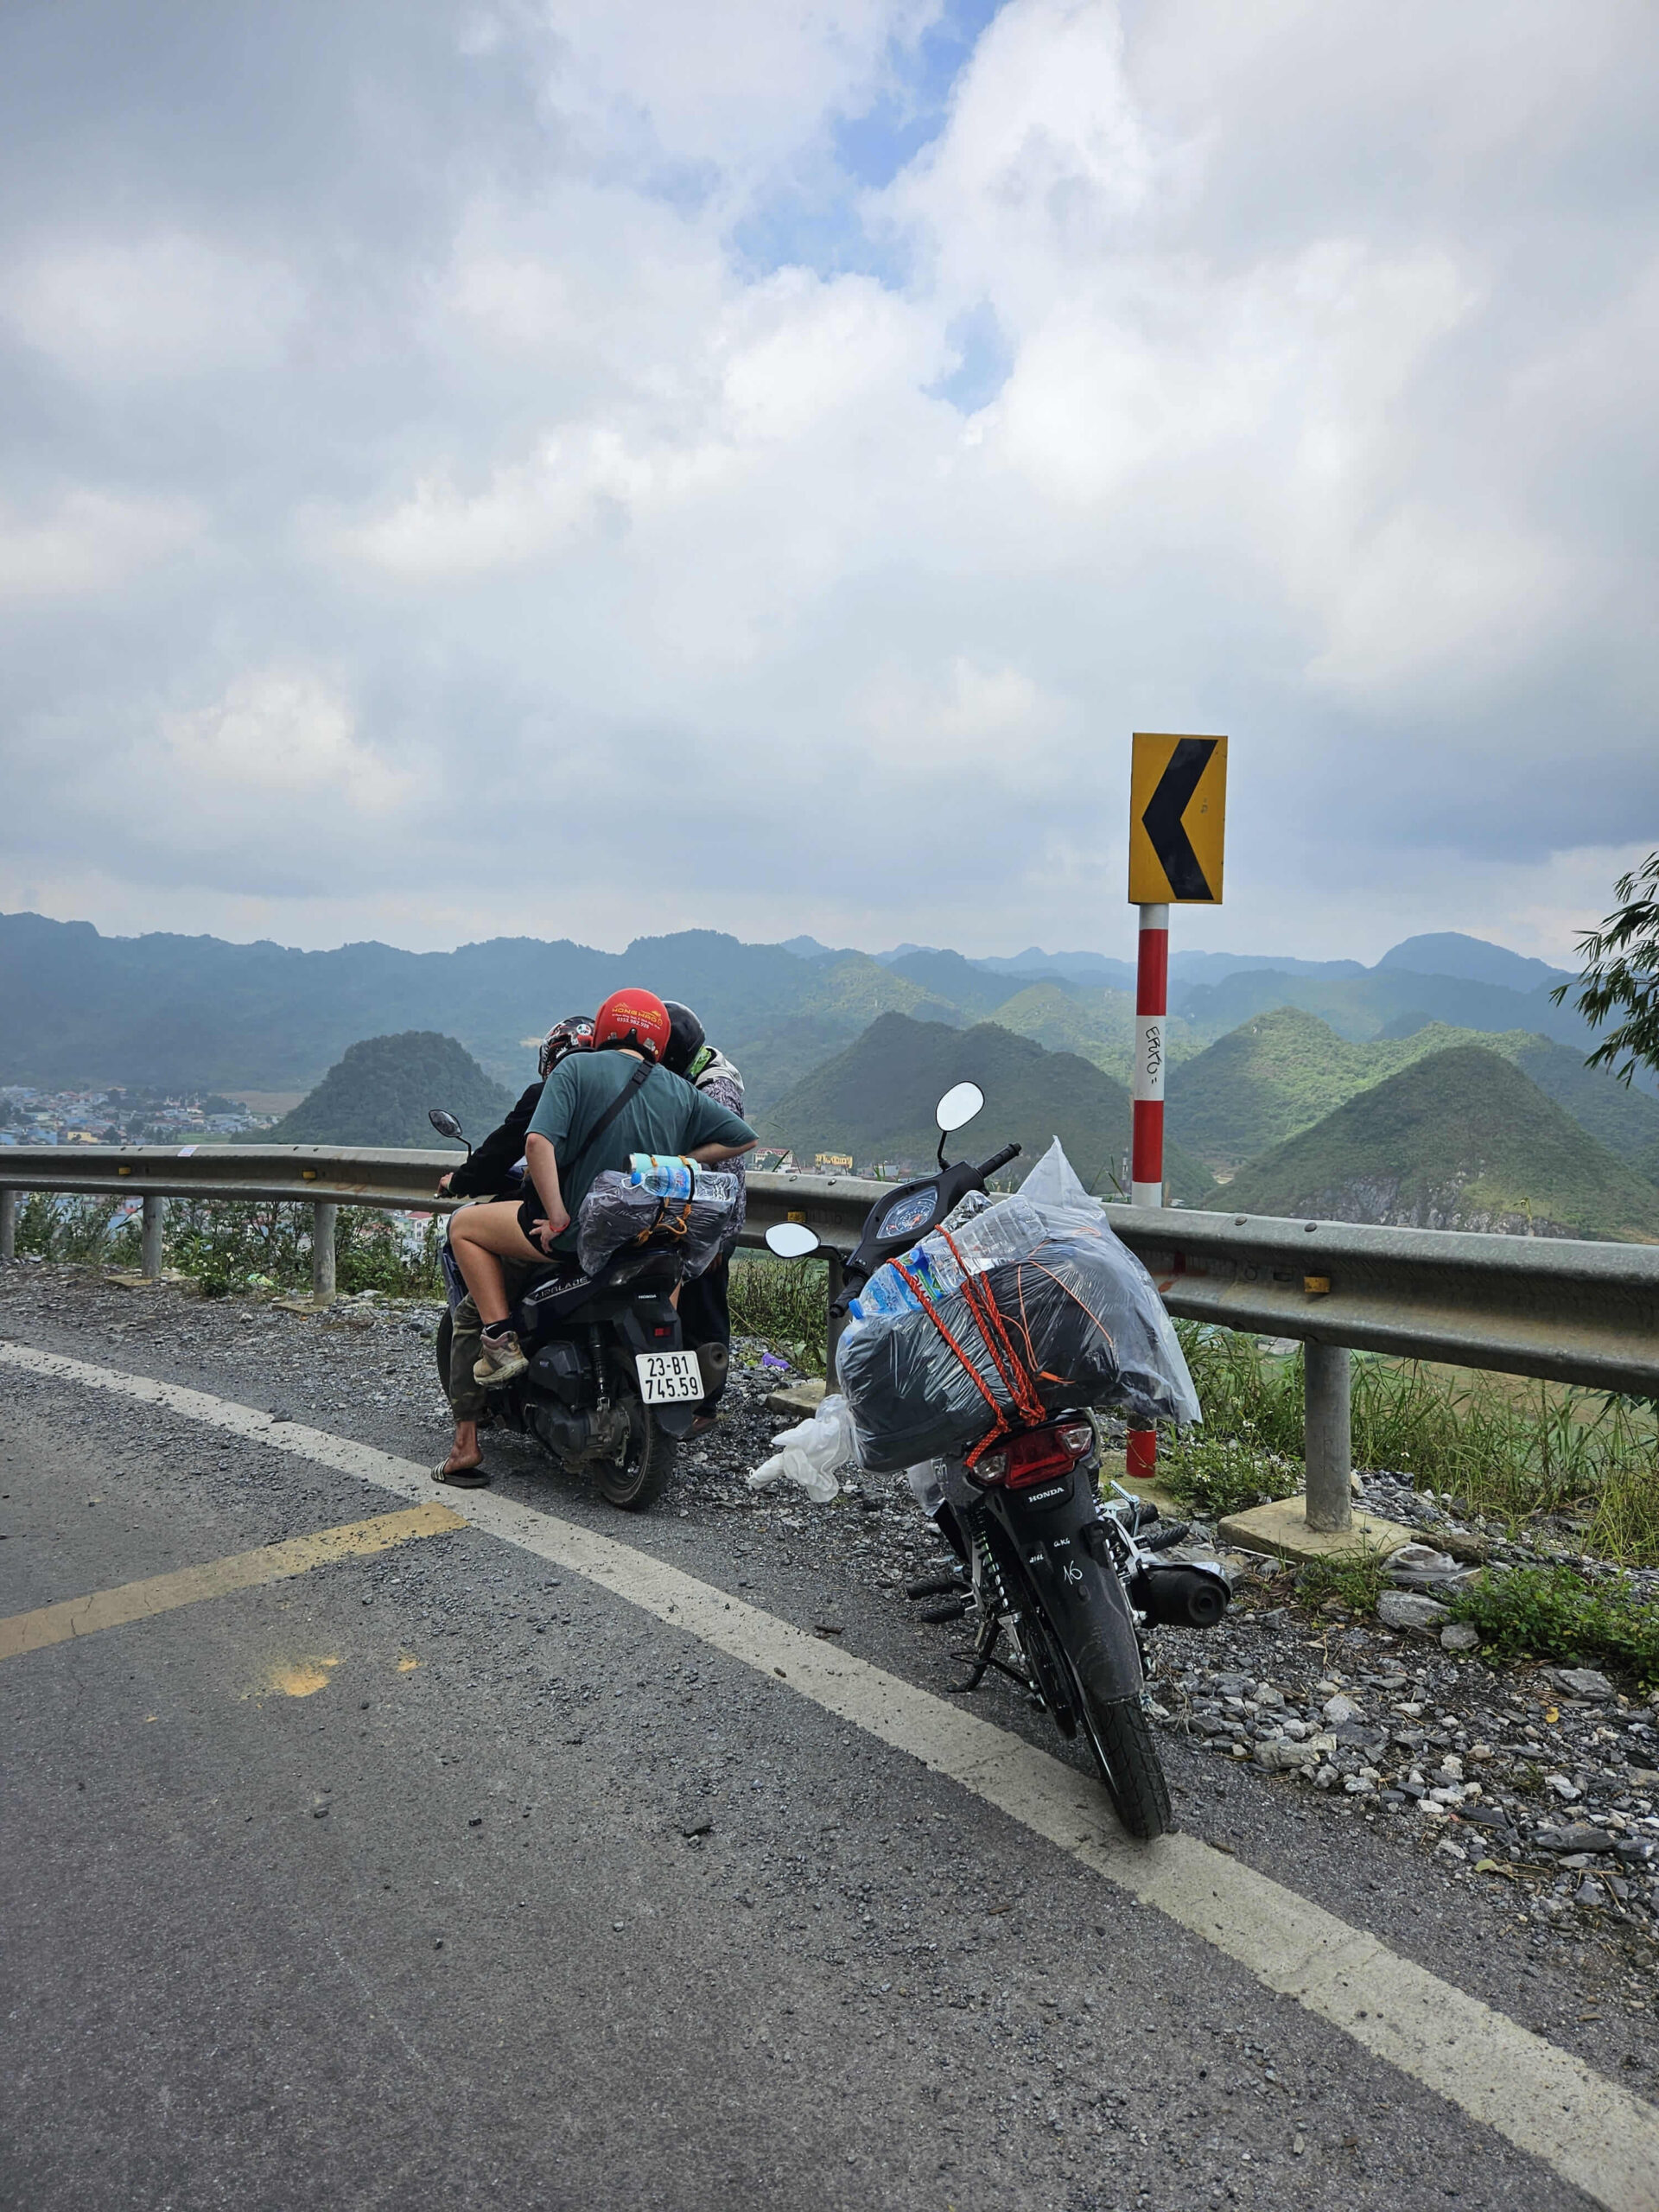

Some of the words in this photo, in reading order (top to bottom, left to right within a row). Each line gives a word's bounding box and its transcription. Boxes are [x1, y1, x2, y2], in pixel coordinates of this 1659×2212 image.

[646, 1355, 690, 1377] 23-B1
[645, 1376, 699, 1400] 745.59
[1028, 1486, 1065, 1503] HONDA
